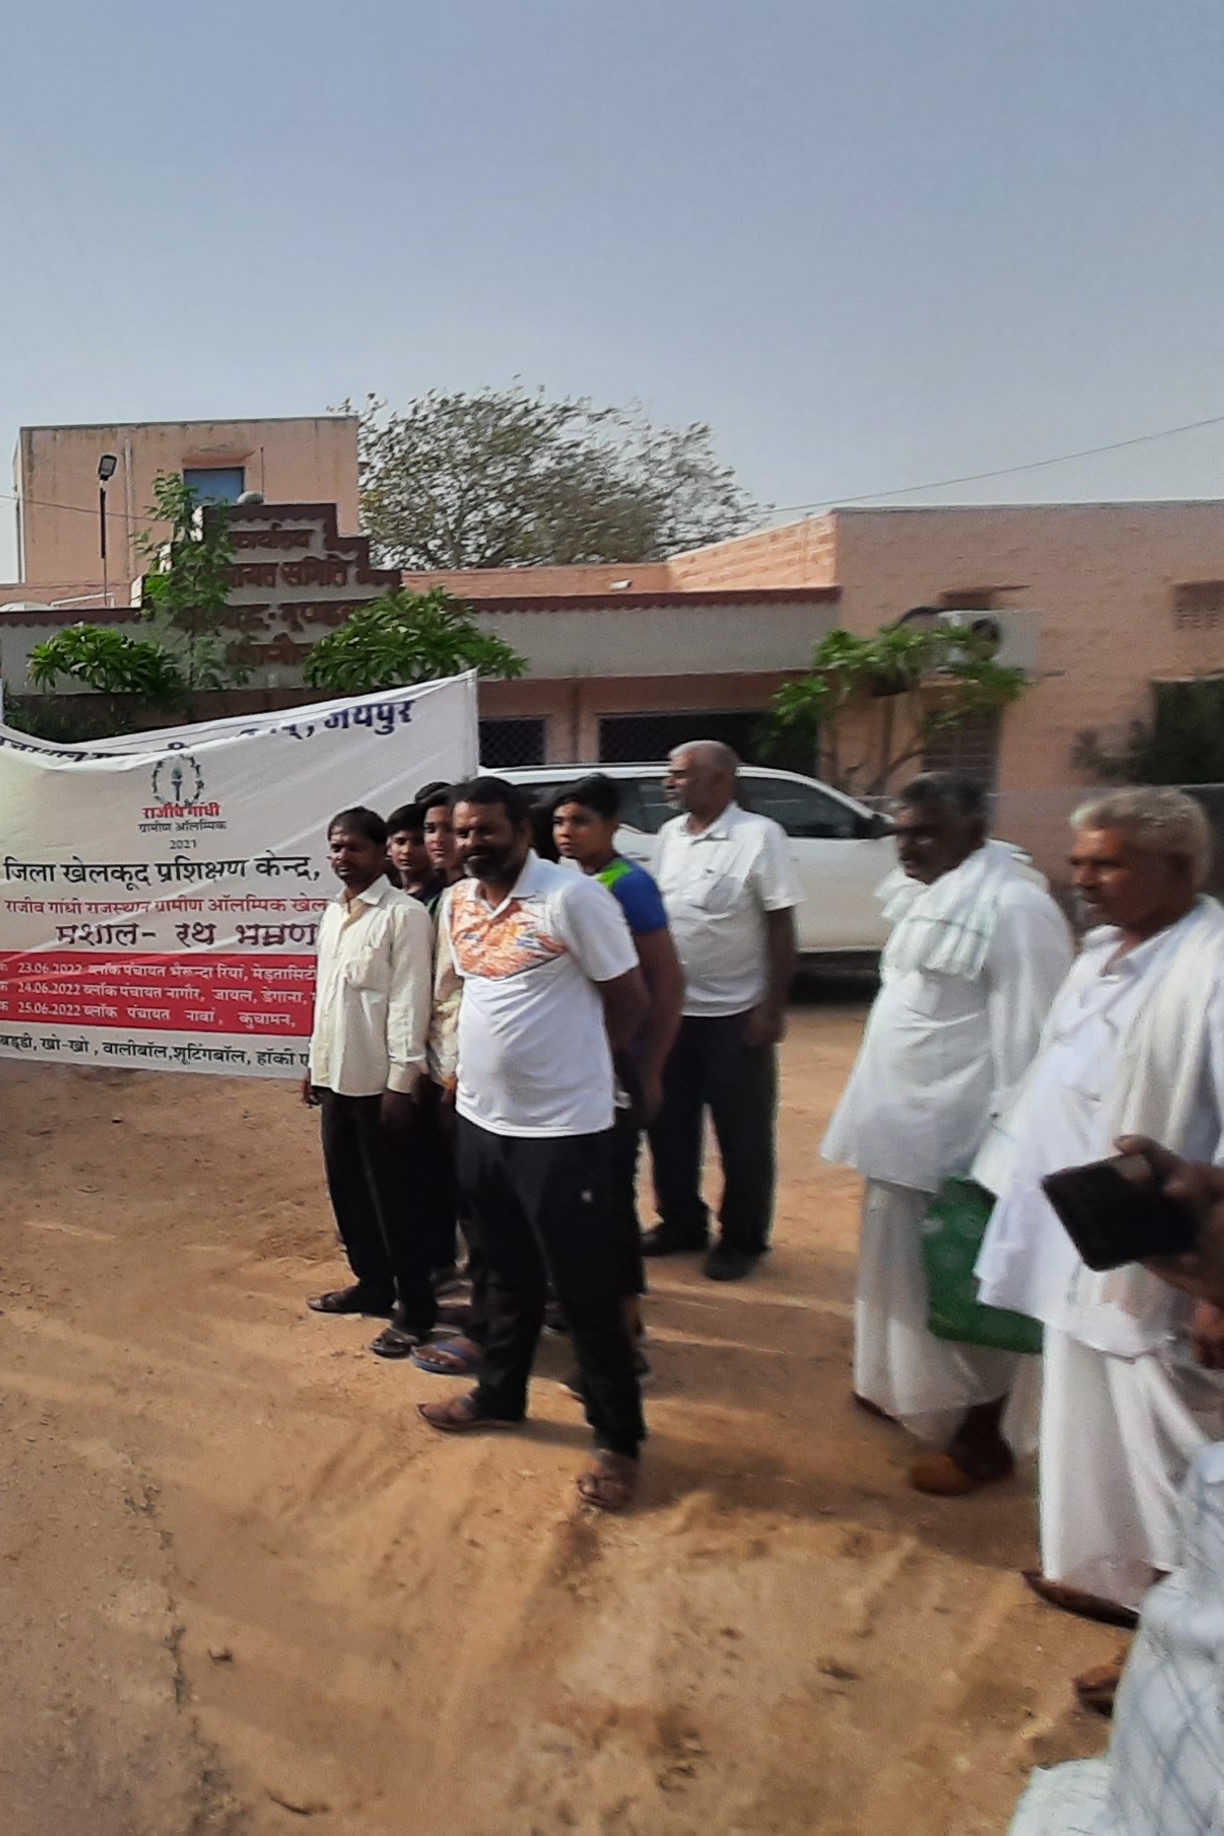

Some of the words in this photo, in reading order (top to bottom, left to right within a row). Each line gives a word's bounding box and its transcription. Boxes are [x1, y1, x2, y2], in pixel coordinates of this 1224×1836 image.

[323, 699, 416, 737] जयपुर
[142, 802, 184, 819] राजीव
[187, 801, 220, 817] गांधी
[137, 820, 172, 833] ग्रामीण
[169, 839, 197, 850] 2021
[3, 855, 56, 883] जिला
[60, 855, 151, 891] खेलकूद
[154, 854, 250, 884] प्रशिक्षण
[253, 849, 321, 881] केन्द्र,
[4, 896, 45, 914] राजीव
[47, 897, 82, 915] गांधी
[84, 901, 151, 915] राजस्थान
[154, 894, 204, 913] ग्रामीण
[174, 921, 216, 948] रथ
[18, 961, 83, 975] 23.06.2022
[88, 961, 121, 976] ब्लॉक
[123, 961, 166, 977] पंचायत
[18, 981, 81, 996] 24.06.2022
[82, 982, 118, 997] ब्लॉक
[119, 982, 162, 998] पंचायत
[163, 983, 205, 1003] नागौर,
[18, 1001, 81, 1017] 25.06.2022
[82, 1003, 118, 1018] ब्लॉक
[127, 1004, 171, 1020] पंचायत
[255, 1048, 295, 1066] हॉकी
